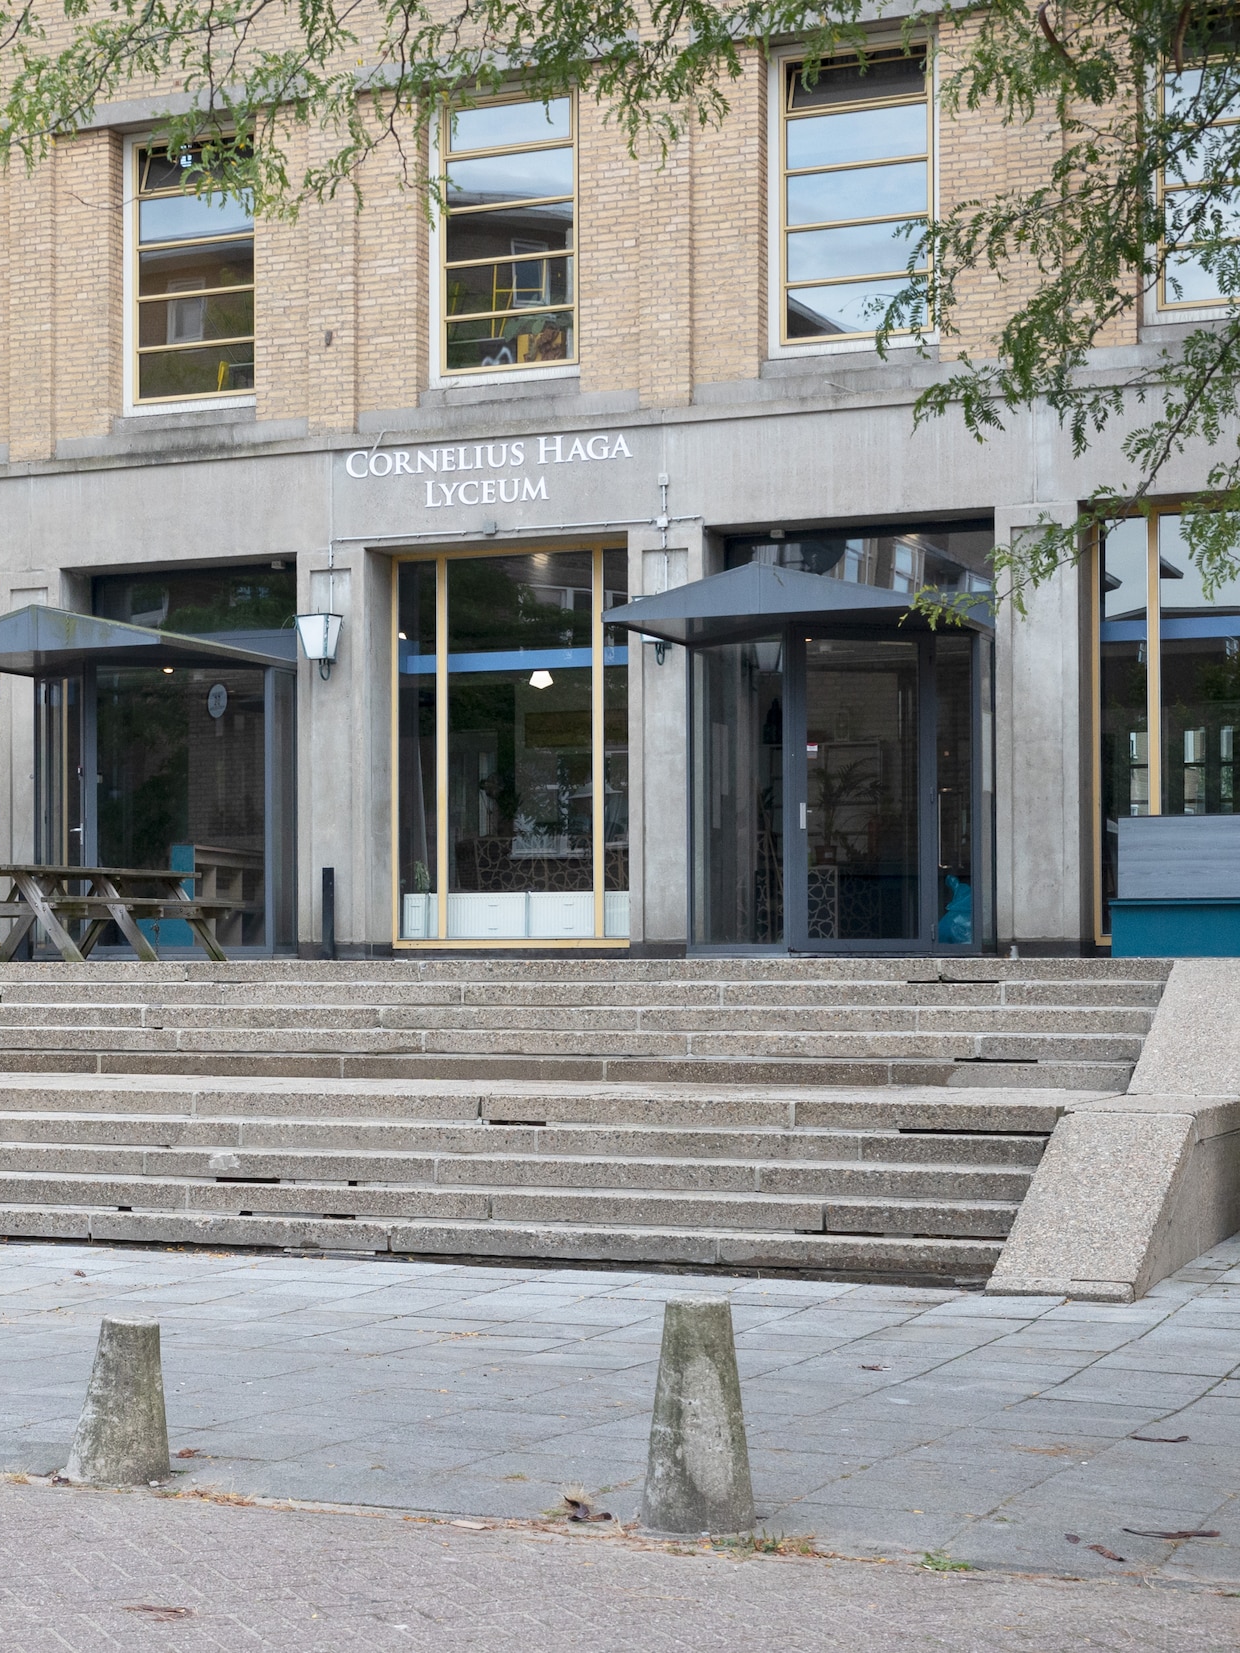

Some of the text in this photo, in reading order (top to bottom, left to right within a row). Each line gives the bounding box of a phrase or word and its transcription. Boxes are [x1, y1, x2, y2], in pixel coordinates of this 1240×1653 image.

[345, 434, 633, 478] CORNELIUS HAGA
[424, 476, 549, 508] LYCEUM
